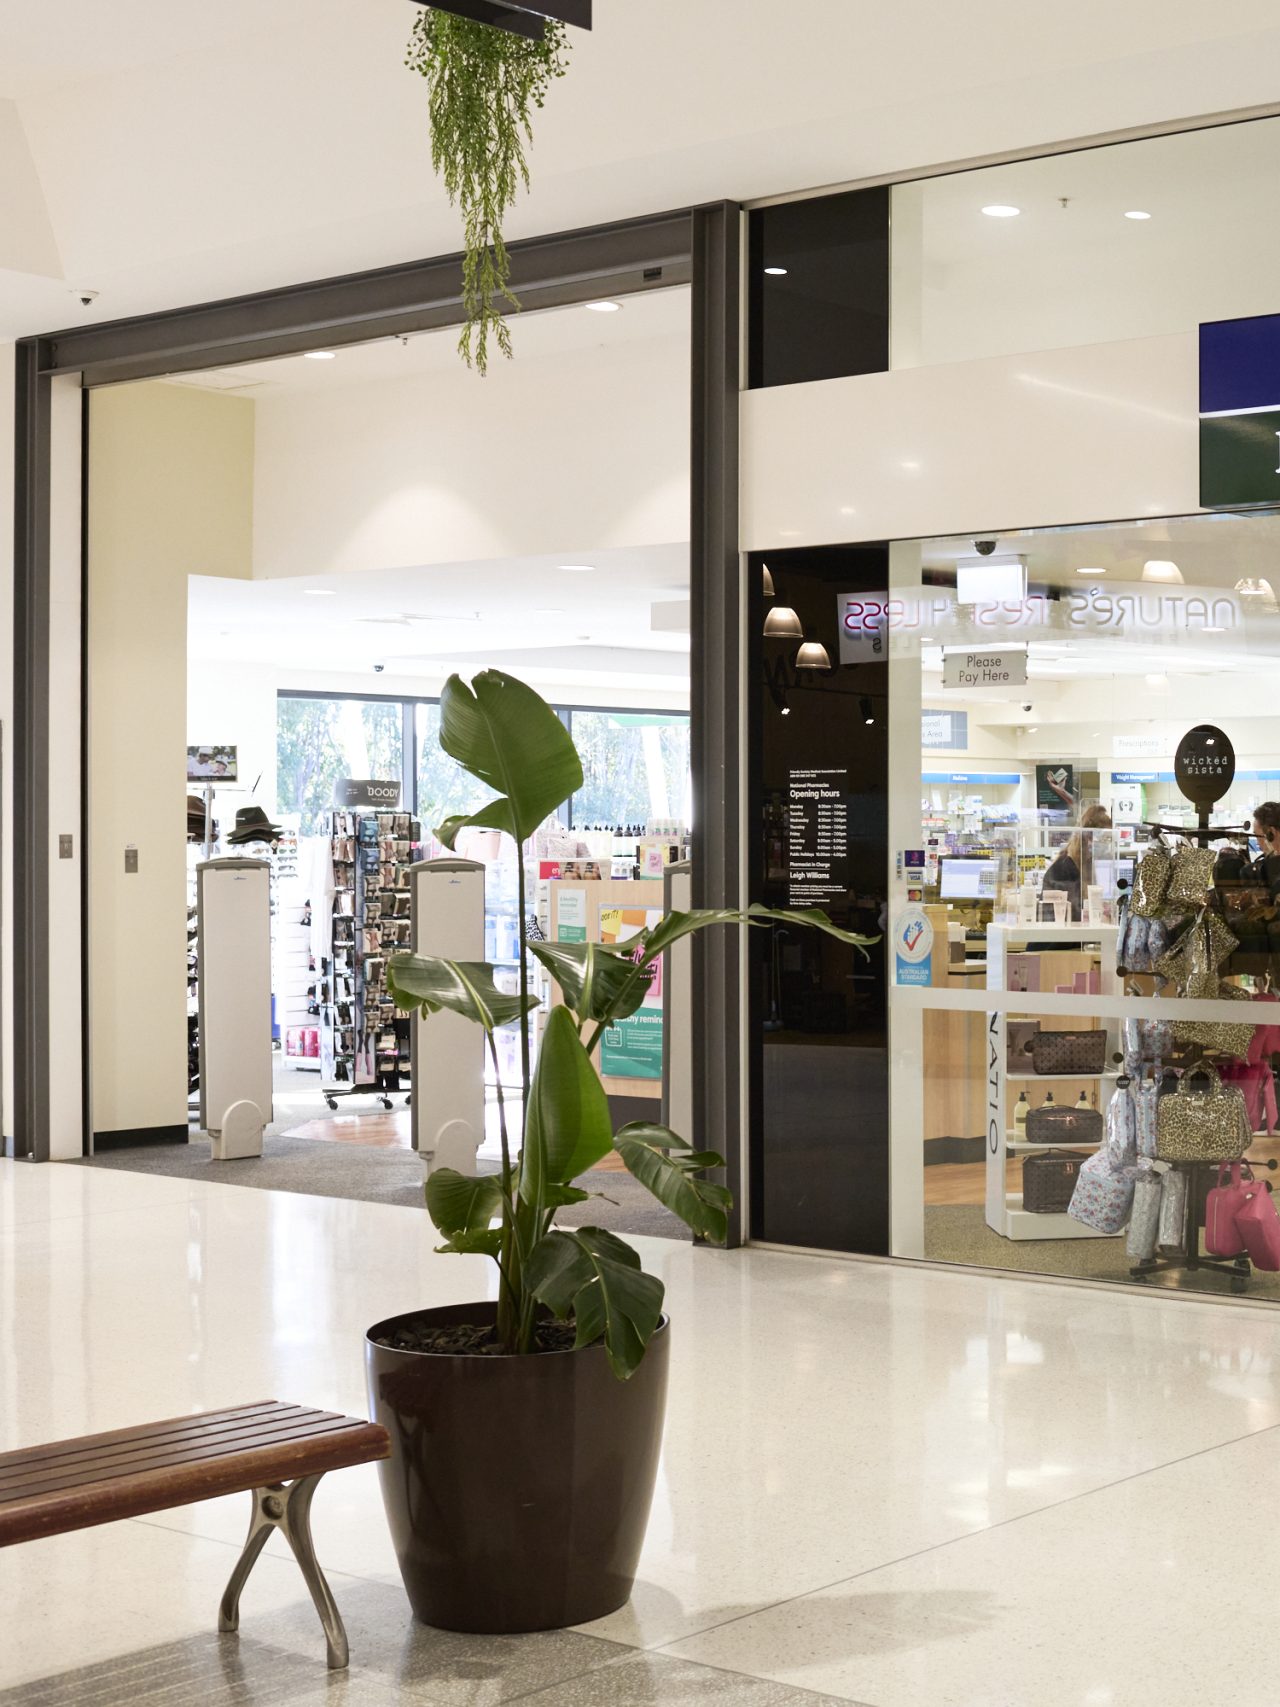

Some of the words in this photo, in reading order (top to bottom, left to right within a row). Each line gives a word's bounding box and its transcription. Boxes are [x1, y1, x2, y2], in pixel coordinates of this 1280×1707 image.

[967, 655, 1002, 668] Please
[959, 671, 979, 685] Pay
[983, 669, 1010, 681] Here
[1183, 755, 1228, 765] wicked
[1187, 766, 1222, 775] sista
[790, 789, 819, 800] Opening
[821, 789, 840, 797] hours
[790, 872, 805, 880] Leigh
